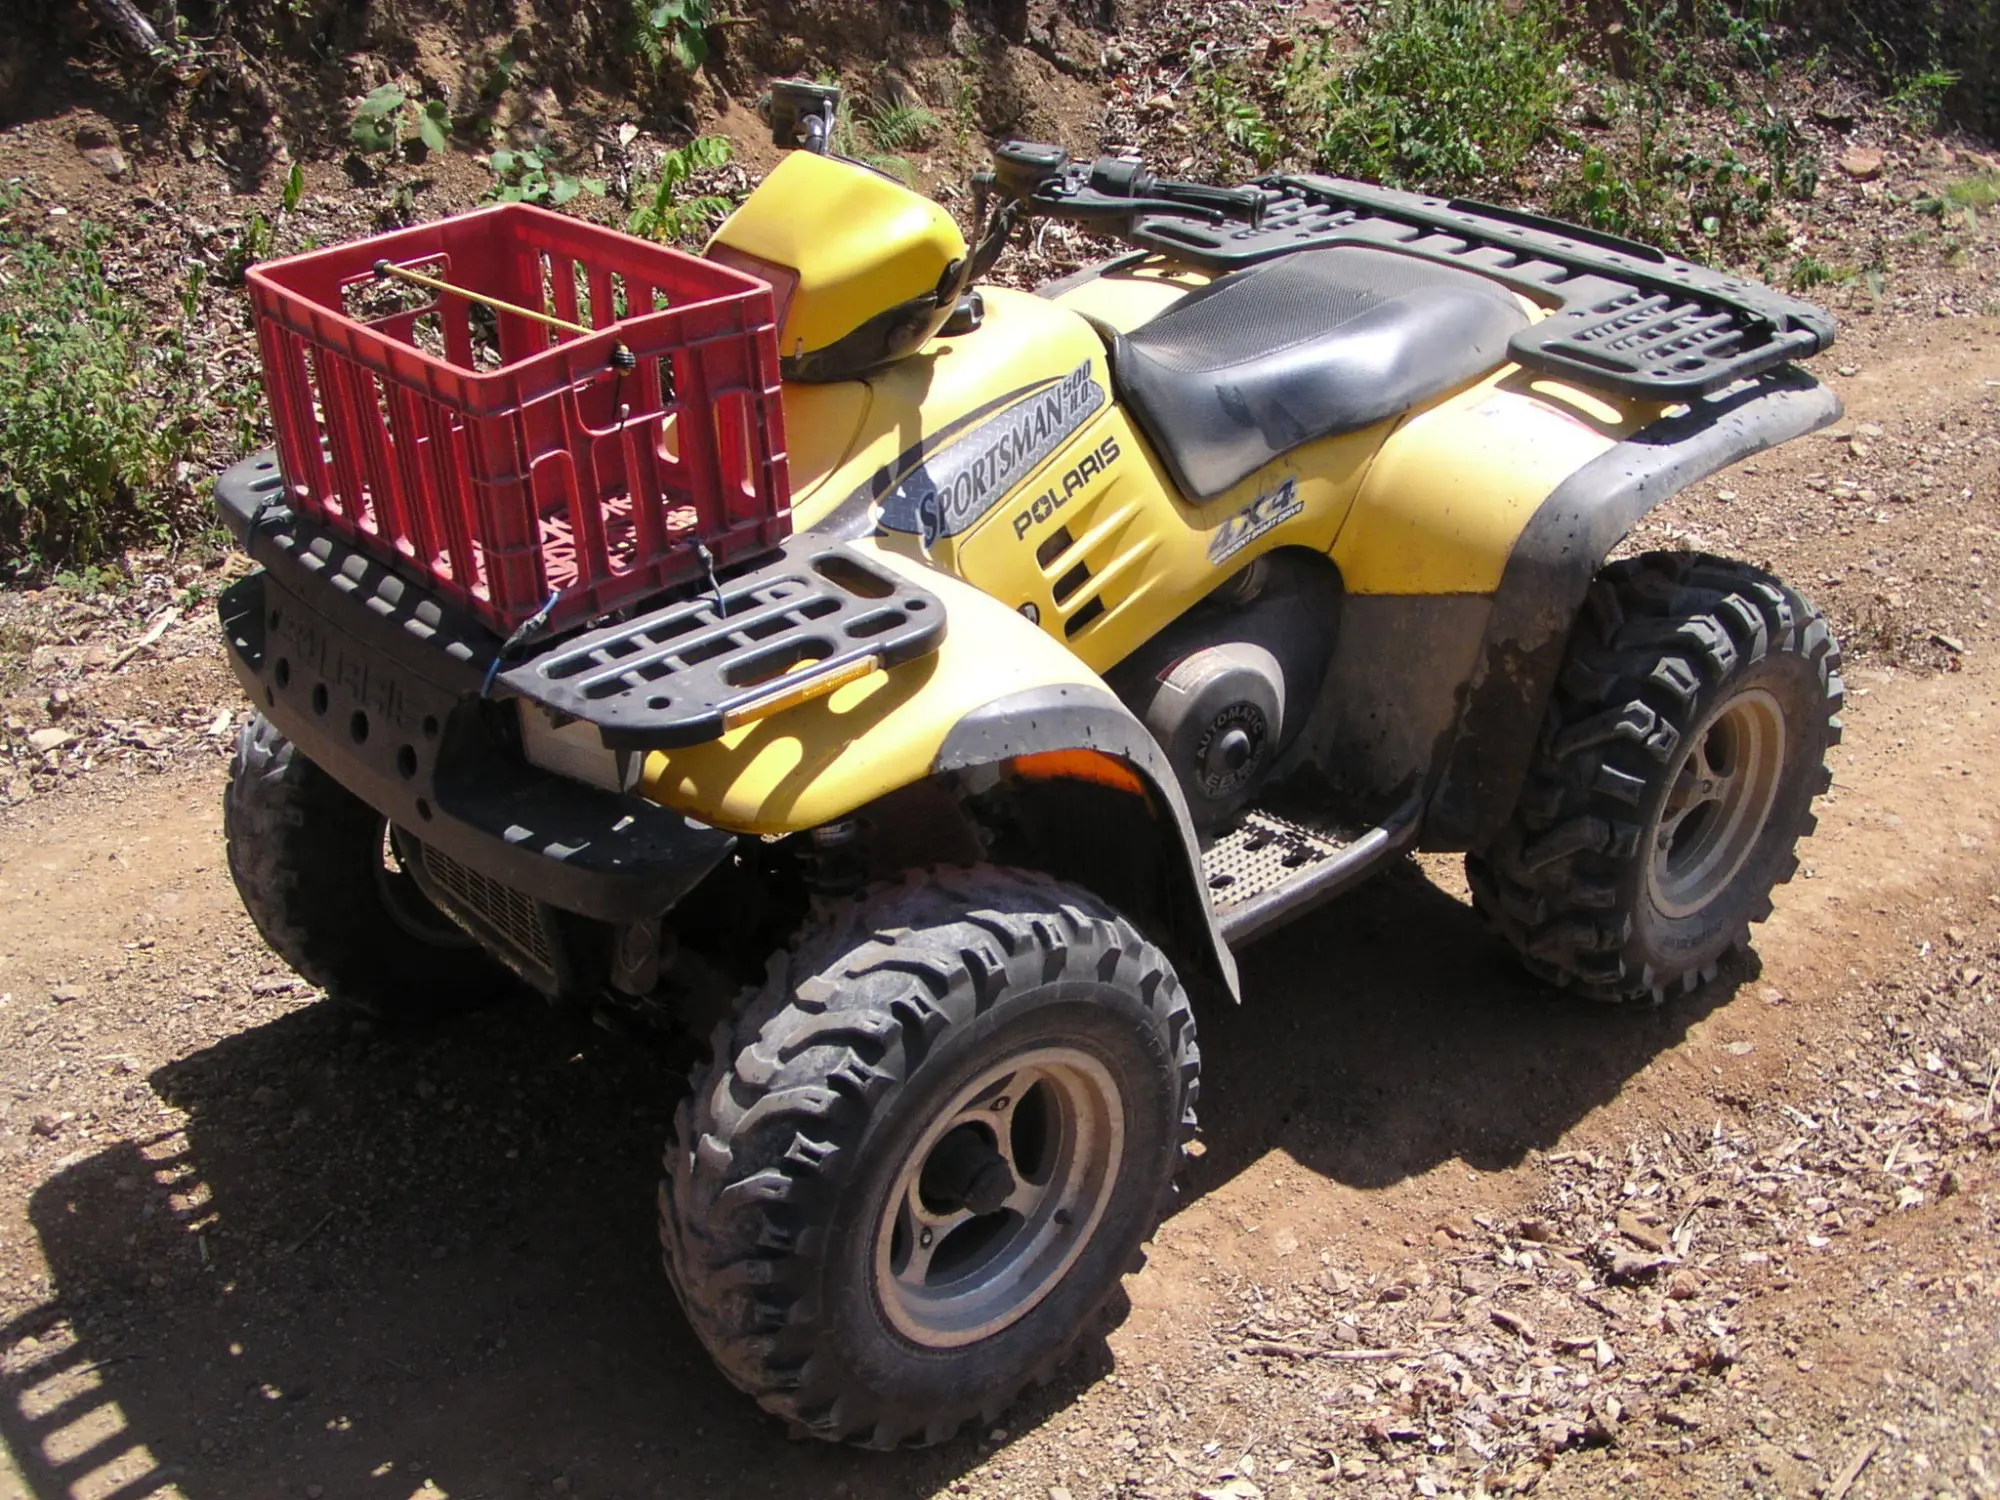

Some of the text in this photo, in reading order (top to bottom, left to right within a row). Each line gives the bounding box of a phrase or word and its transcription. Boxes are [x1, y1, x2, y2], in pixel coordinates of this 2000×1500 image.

[1062, 359, 1091, 399] 500
[920, 387, 1062, 548] SPORTSMAN
[1012, 435, 1121, 541] POLARIS
[1197, 704, 1264, 758] AUTOMATIC
